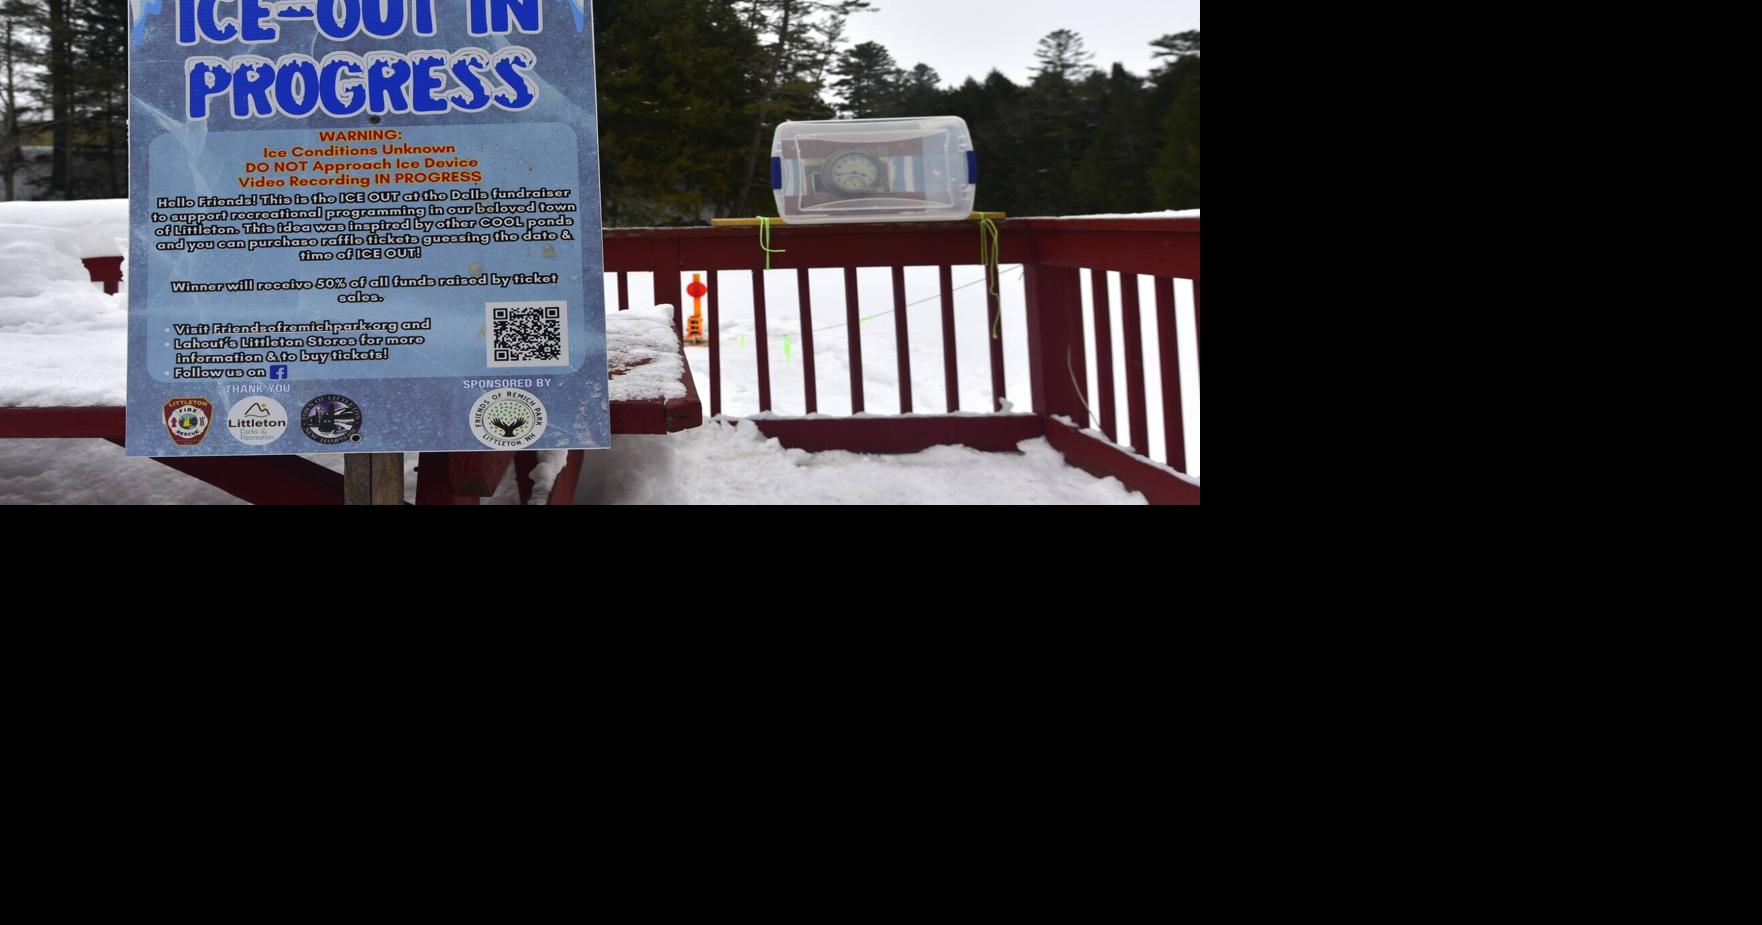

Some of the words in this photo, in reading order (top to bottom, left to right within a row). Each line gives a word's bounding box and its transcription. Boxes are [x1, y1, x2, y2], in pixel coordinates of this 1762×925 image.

[178, 0, 436, 44] ICE-OUT
[467, 0, 540, 34] IN
[187, 50, 536, 119] PROGRESS
[320, 129, 402, 142] WARNING:
[264, 148, 286, 158] Ice
[292, 144, 378, 157] Conditions
[382, 143, 456, 154] Unknown
[246, 162, 269, 173] DO
[274, 161, 308, 172] NOT
[312, 158, 392, 174] Approach
[396, 158, 420, 169] Ice
[424, 157, 478, 168] Device
[238, 176, 285, 188] Video
[290, 174, 370, 188] Recording
[375, 174, 390, 184] IN
[395, 172, 482, 184] PROGRESS
[158, 197, 194, 208] Hello
[198, 195, 258, 207] Friends!
[260, 194, 291, 206] This
[294, 194, 308, 204] is
[312, 193, 336, 204] the
[339, 193, 364, 204] ICE
[368, 192, 400, 202] OUT
[402, 192, 420, 202] at
[422, 190, 448, 201] the
[450, 189, 488, 200] Dells
[492, 188, 571, 200] fundraiser
[152, 212, 172, 222] to
[172, 210, 228, 224] support
[230, 207, 322, 220] recreational
[325, 205, 426, 220] programming
[429, 205, 444, 216] in
[447, 206, 473, 215] our
[476, 202, 536, 214] beloved
[539, 202, 576, 213] town
[155, 226, 171, 236] of
[173, 224, 240, 236] Littleton.
[242, 223, 274, 234] This
[277, 222, 312, 234] idea
[314, 222, 346, 232] was
[348, 219, 414, 233] inspired
[414, 218, 432, 232] by
[435, 217, 476, 229] other
[478, 216, 524, 228] COOL
[526, 214, 574, 229] ponds
[156, 238, 186, 250] and
[186, 240, 214, 252] you
[217, 240, 245, 250] can
[248, 236, 318, 251] purchase
[320, 235, 364, 246] raffle
[367, 233, 418, 246] tickets
[422, 232, 490, 246] guessing
[493, 230, 518, 242] the
[522, 230, 558, 242] date
[560, 230, 574, 240] &
[299, 250, 333, 262] time
[336, 249, 354, 260] of
[356, 248, 382, 260] ICE
[384, 246, 422, 258] OUT!
[170, 280, 224, 292] Winner
[225, 279, 254, 292] will
[256, 279, 313, 290] receive
[314, 278, 347, 290] 50%
[350, 276, 366, 288] of
[368, 275, 390, 288] all
[392, 274, 436, 287] funds
[438, 274, 487, 286] raised
[490, 274, 511, 288] by
[512, 272, 558, 285] ticket
[337, 292, 384, 302] sales.
[174, 324, 208, 336] Visit
[212, 320, 398, 335] Friendsofremichpark.org
[400, 318, 431, 330] and
[240, 336, 304, 348] Littleton
[306, 335, 356, 348] Stores
[360, 334, 383, 346] for
[385, 335, 426, 345] more
[176, 352, 263, 364] information
[266, 352, 280, 362] &
[280, 352, 297, 363] to
[300, 350, 328, 364] buy
[330, 348, 389, 362] tickets!
[174, 368, 224, 380] Follow
[226, 368, 244, 378] us
[246, 367, 266, 378] on
[226, 384, 263, 394] THANK
[268, 383, 290, 392] YOU
[463, 379, 532, 388] SPONSORED
[536, 378, 552, 387] BY
[474, 399, 490, 428] FRIENDS
[506, 391, 536, 406] REMICH
[534, 408, 542, 426] PARK
[228, 419, 286, 428] Littleton
[525, 433, 536, 442] NH
